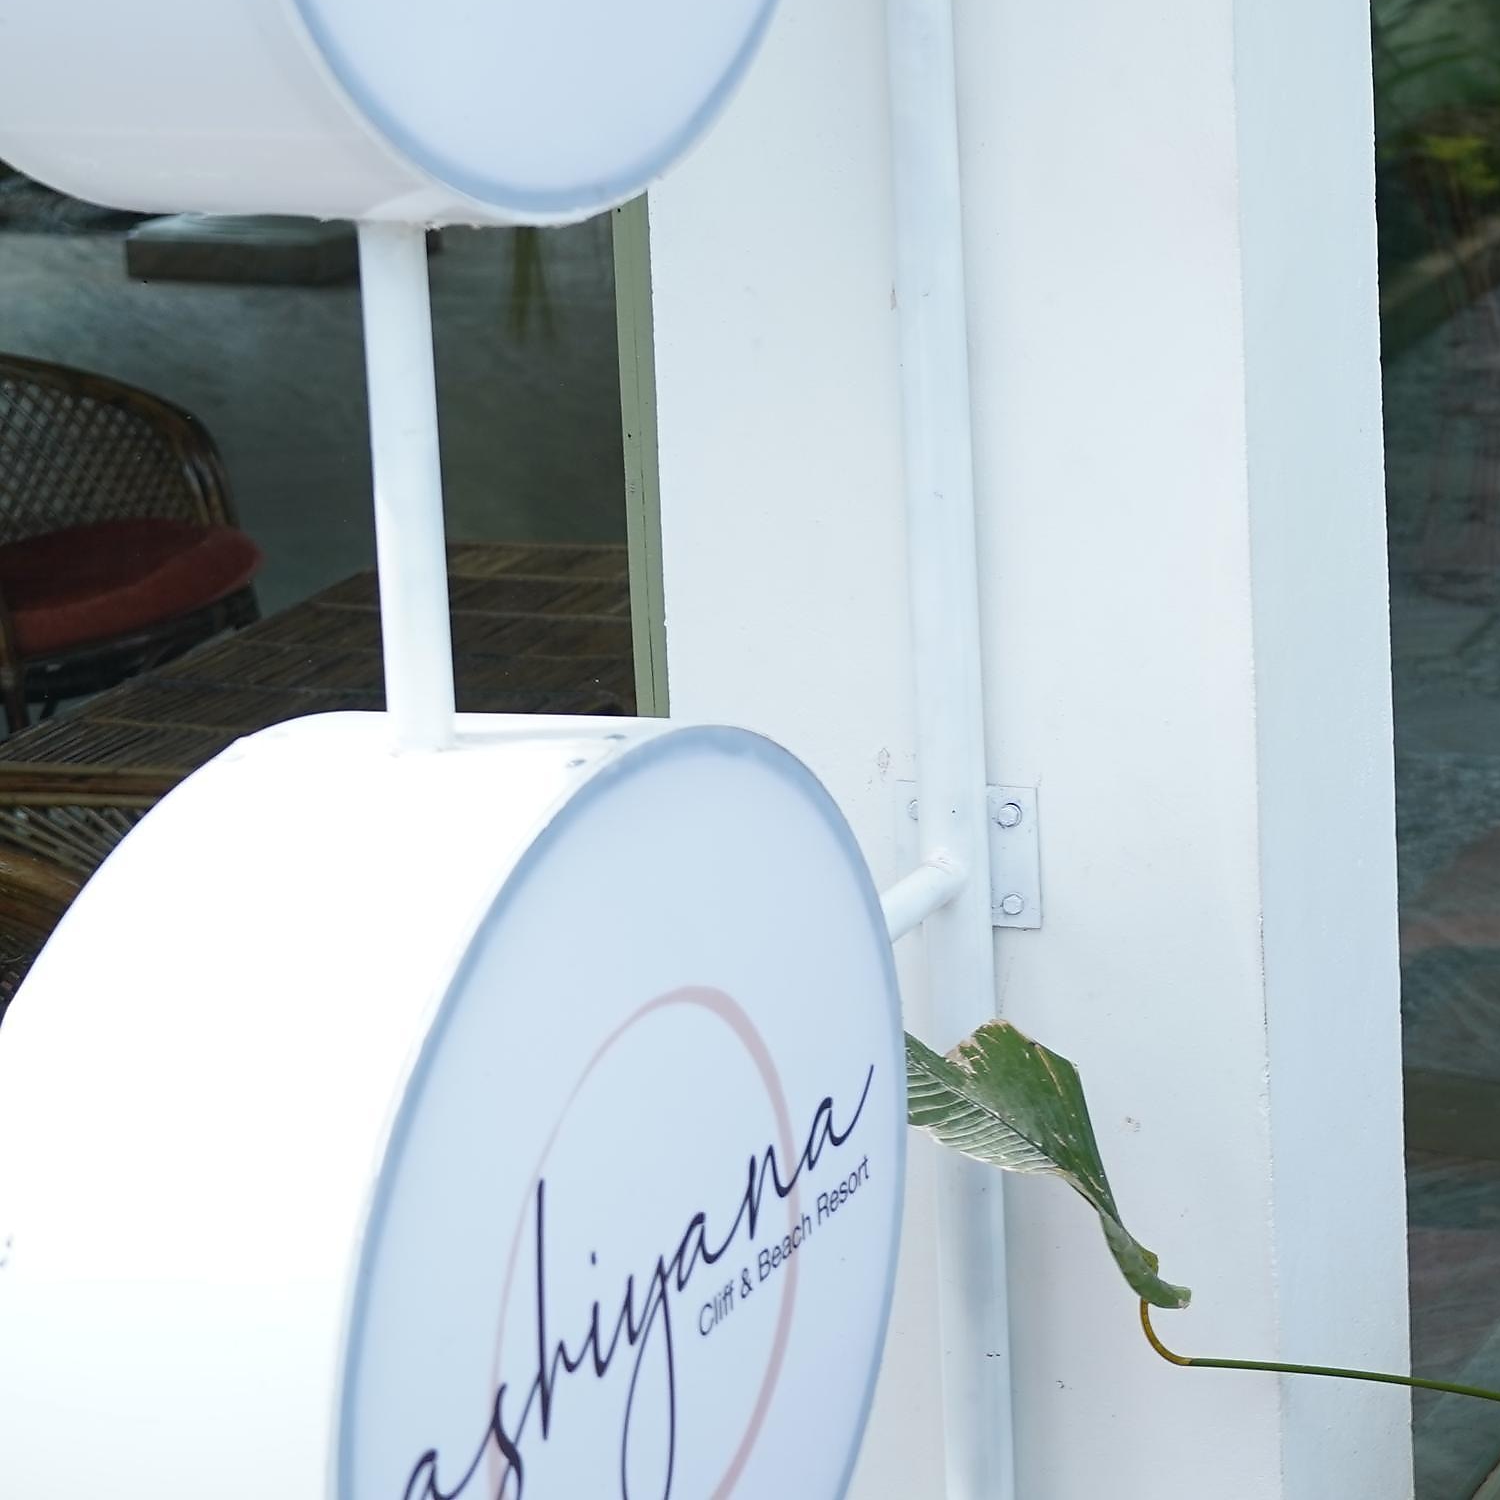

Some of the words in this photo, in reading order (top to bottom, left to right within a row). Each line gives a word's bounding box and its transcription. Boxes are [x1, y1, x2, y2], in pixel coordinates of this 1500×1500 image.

[403, 1064, 873, 1500] ashiyana
[699, 1280, 734, 1336] Cliff
[740, 1268, 753, 1299] &
[758, 1213, 812, 1282] Beach
[816, 1155, 869, 1226] Resort
